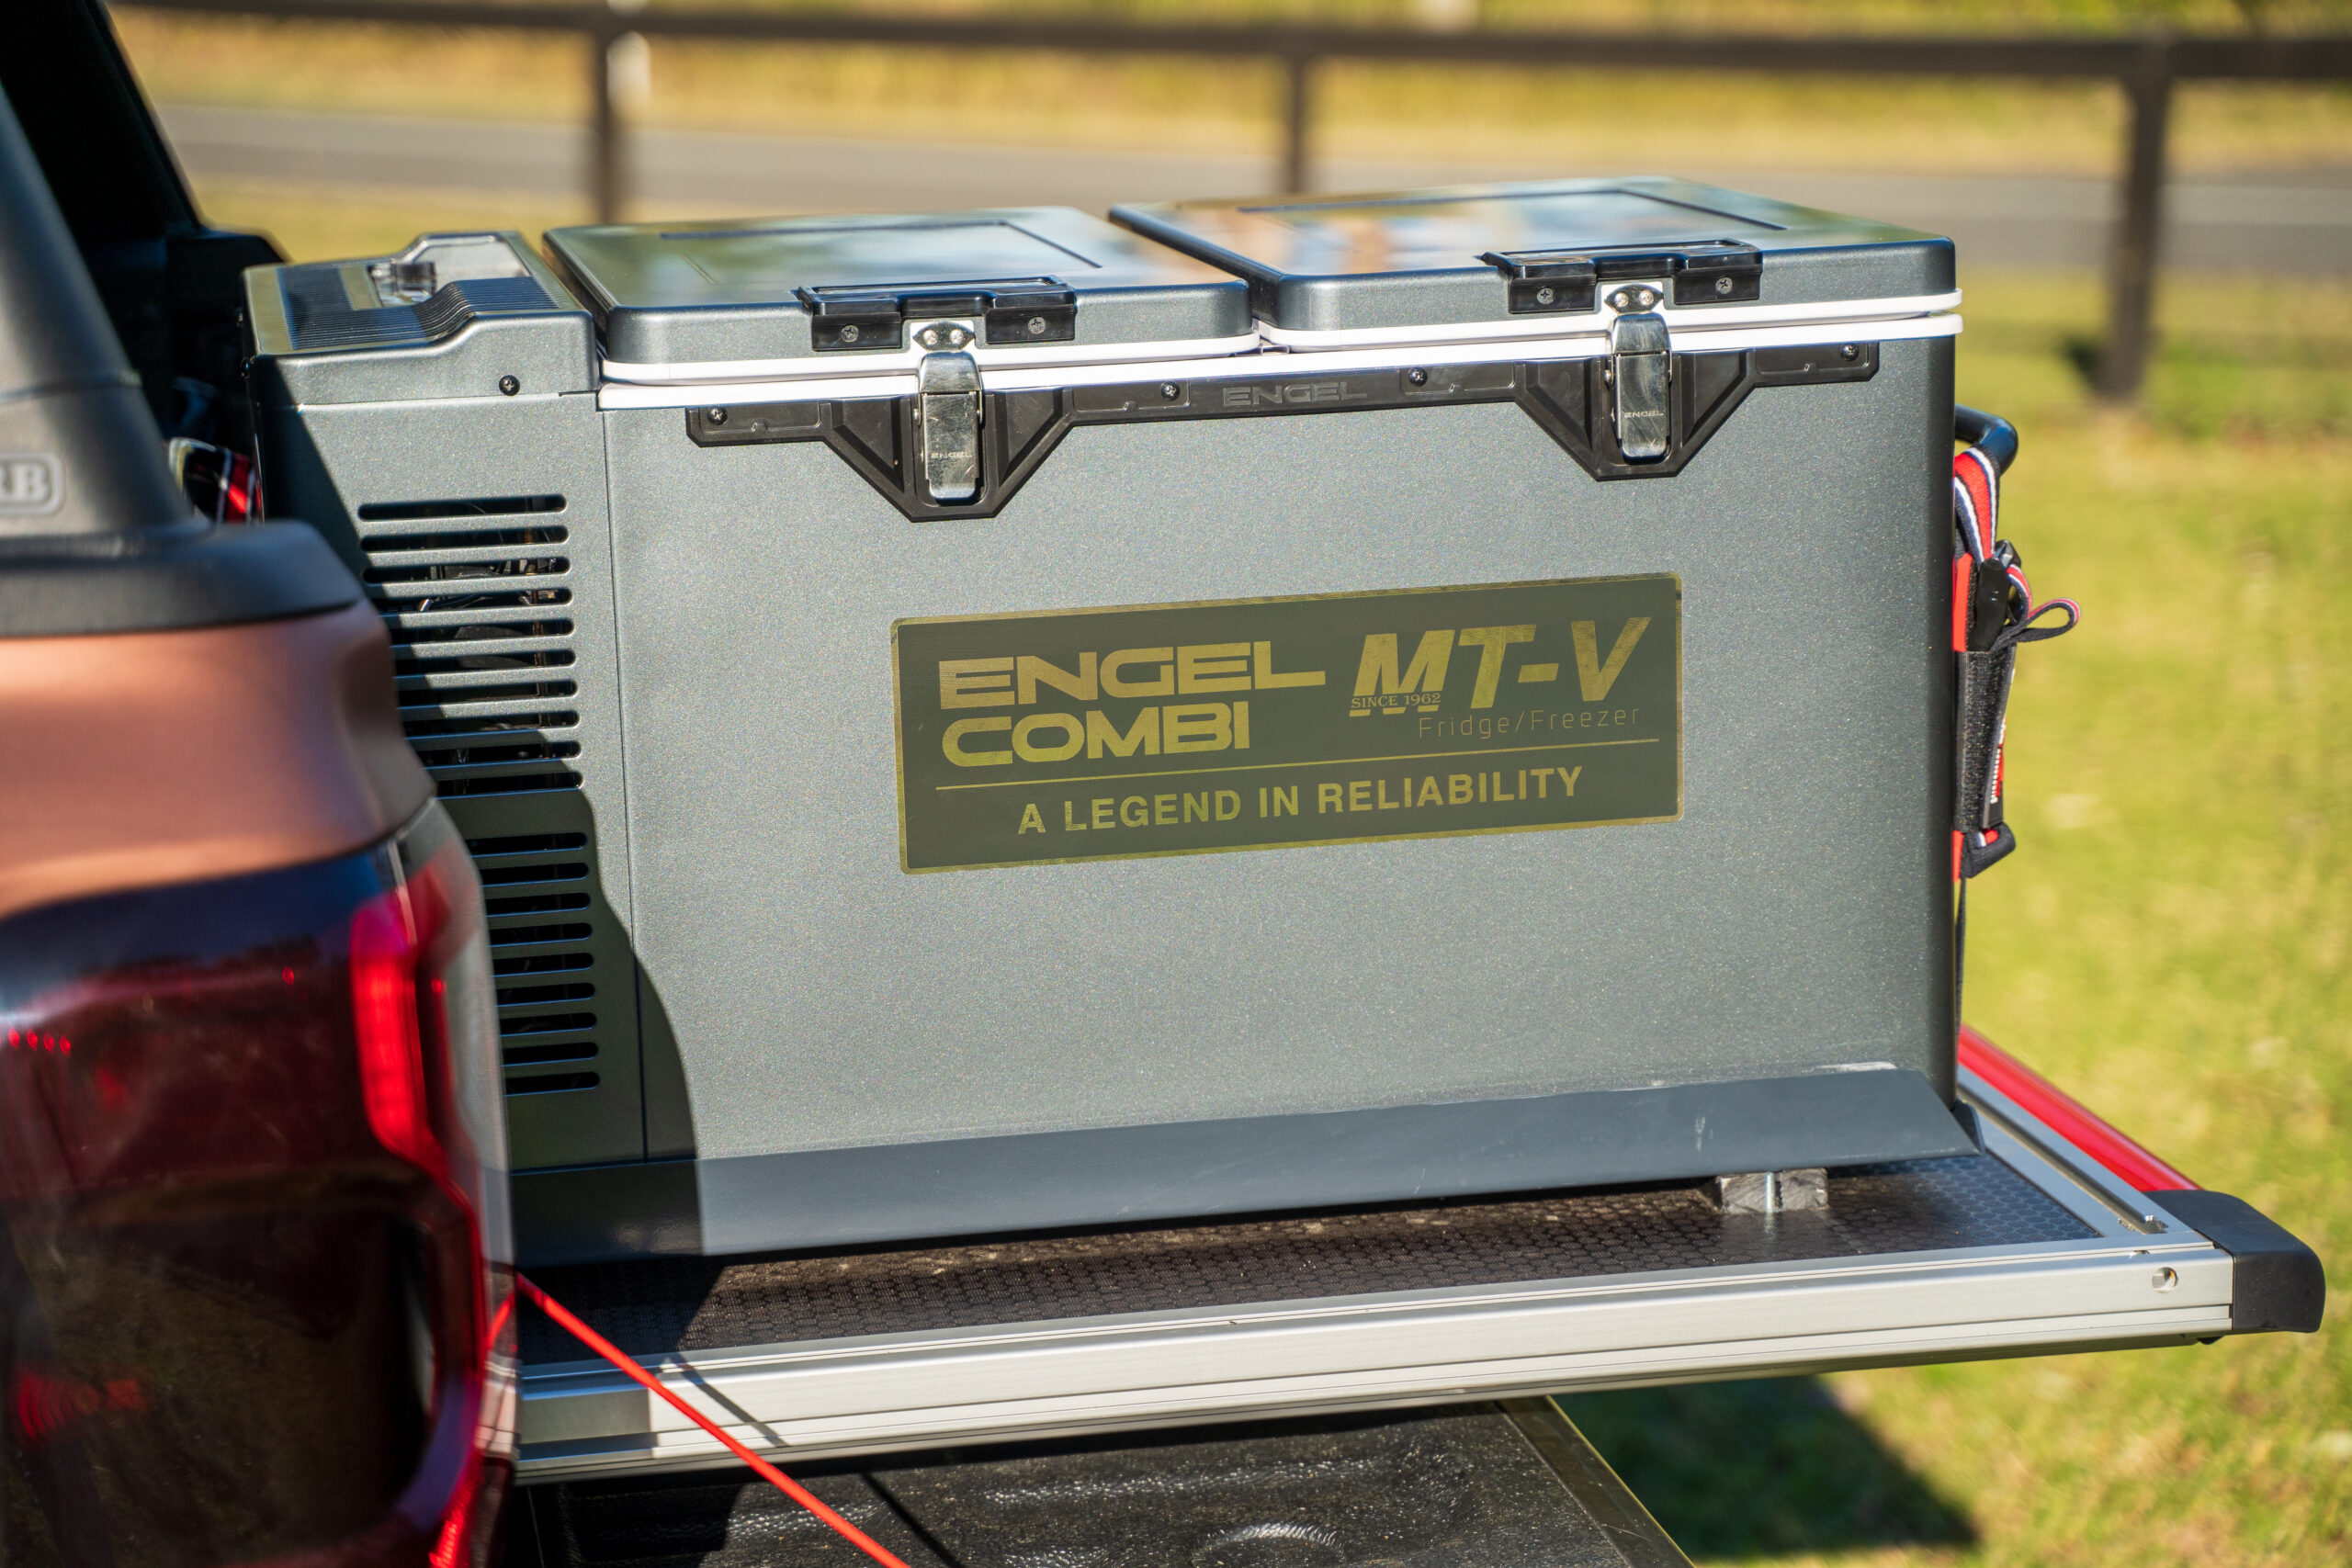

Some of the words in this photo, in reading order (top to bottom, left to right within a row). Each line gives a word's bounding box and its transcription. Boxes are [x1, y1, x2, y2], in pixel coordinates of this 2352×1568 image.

[1223, 381, 1368, 407] ENGEL
[1623, 410, 1665, 419] ENGEL
[930, 450, 973, 459] ENGEL
[939, 640, 1326, 709] ENGEL
[1350, 616, 1651, 716] MT-V
[1351, 695, 1397, 708] SINCE
[1403, 693, 1442, 706] 1962
[942, 701, 1250, 768] COMBI
[1419, 707, 1640, 739] Fridge/Freezer
[1017, 803, 1046, 835] A
[1065, 790, 1241, 832] LEGEND
[1260, 785, 1300, 818] IN
[1317, 766, 1585, 814] RELIABILITY
